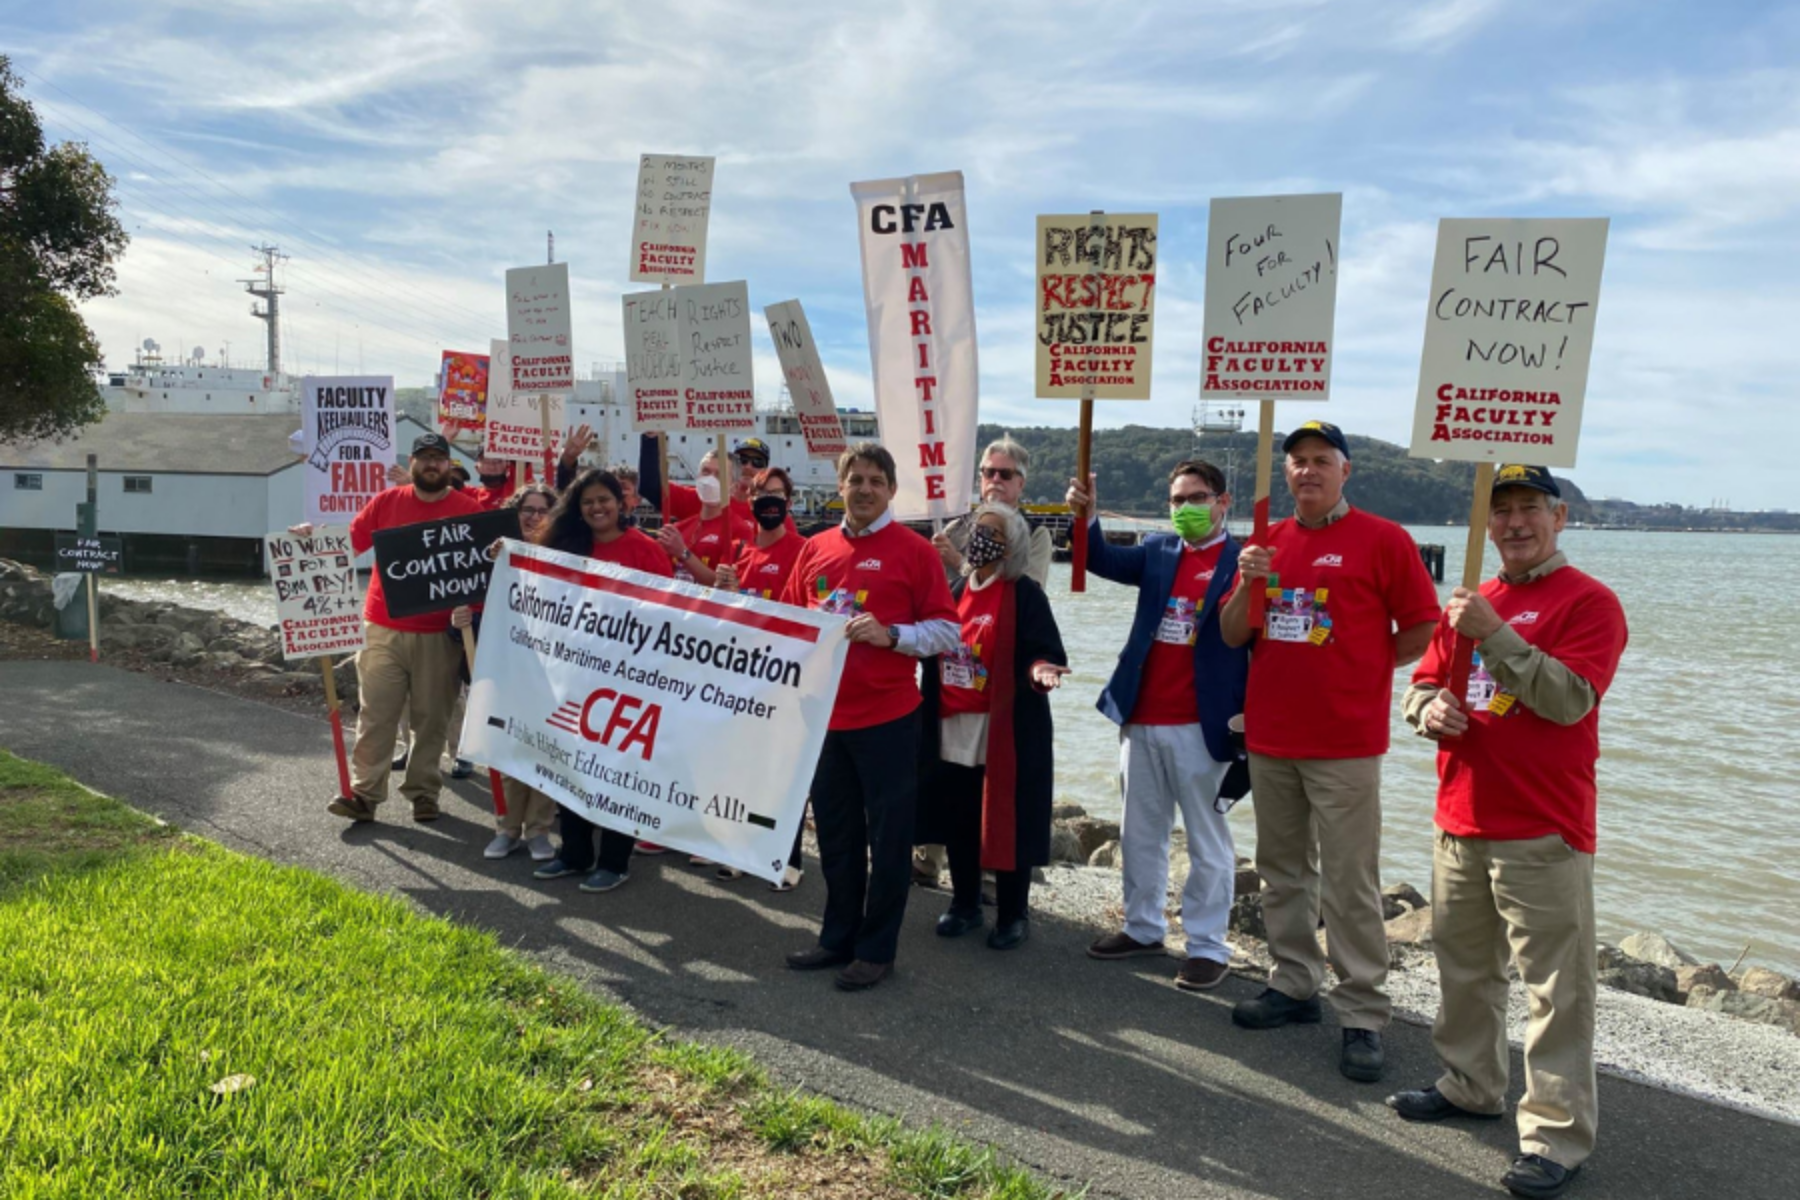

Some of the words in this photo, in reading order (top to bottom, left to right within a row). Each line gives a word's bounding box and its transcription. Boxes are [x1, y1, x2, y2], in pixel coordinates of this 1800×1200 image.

[643, 158, 655, 169] 2
[871, 202, 955, 234] CFA
[1045, 225, 1156, 270] RIGHTS
[1225, 223, 1283, 268] FOUR
[1256, 251, 1293, 277] FOR
[1465, 236, 1567, 278] FAIR
[1041, 273, 1155, 312] RESPECT
[1435, 288, 1589, 323] CONTRACT
[770, 319, 803, 349] TWO
[1039, 312, 1150, 345] JUSTICE
[1049, 344, 1137, 357] CALIFORNIA
[1207, 337, 1326, 353] CALIFORNIA
[1466, 336, 1568, 370] NOW!
[512, 355, 571, 367] CALIFORNIA
[1050, 359, 1135, 371] FACULTY
[1206, 356, 1325, 372] FACULTY
[512, 367, 571, 379] FACULTY
[900, 243, 946, 500] MARITIME
[1048, 374, 1135, 386] ASSOCIATION
[512, 379, 573, 390] ASSOCIATION
[1204, 374, 1326, 391] ASSOCIATION
[317, 387, 386, 409] FACULTY
[494, 393, 519, 409] WE
[684, 387, 753, 401] CALIFORNIA
[1436, 383, 1561, 405] CALIFORNIA
[686, 402, 752, 414] FACULTY
[1435, 404, 1557, 426] FACULTY
[489, 420, 560, 438] CALIFORIA
[686, 416, 754, 429] ASSOCIATION
[489, 432, 559, 448] FACULY
[1430, 424, 1554, 445] ASSOCIATION
[339, 446, 361, 460] FOR
[363, 446, 373, 460] A
[331, 461, 386, 493] FAIR
[269, 539, 293, 558] NO
[299, 557, 328, 572] FOR
[429, 572, 487, 600] NOW!
[303, 595, 332, 615] 4%
[282, 614, 360, 630] CALIFORNIA
[284, 625, 360, 642] FACULTY
[508, 581, 573, 628] California
[573, 600, 652, 656] Faculty
[653, 621, 801, 688] Association
[286, 638, 363, 654] ASSOCIATION
[553, 641, 611, 673] Maritime
[613, 659, 696, 702] Academy
[700, 683, 776, 720] Chapter
[580, 687, 662, 762] CFA
[573, 749, 661, 799] Education
[667, 780, 700, 811] for
[703, 794, 745, 823] All!
